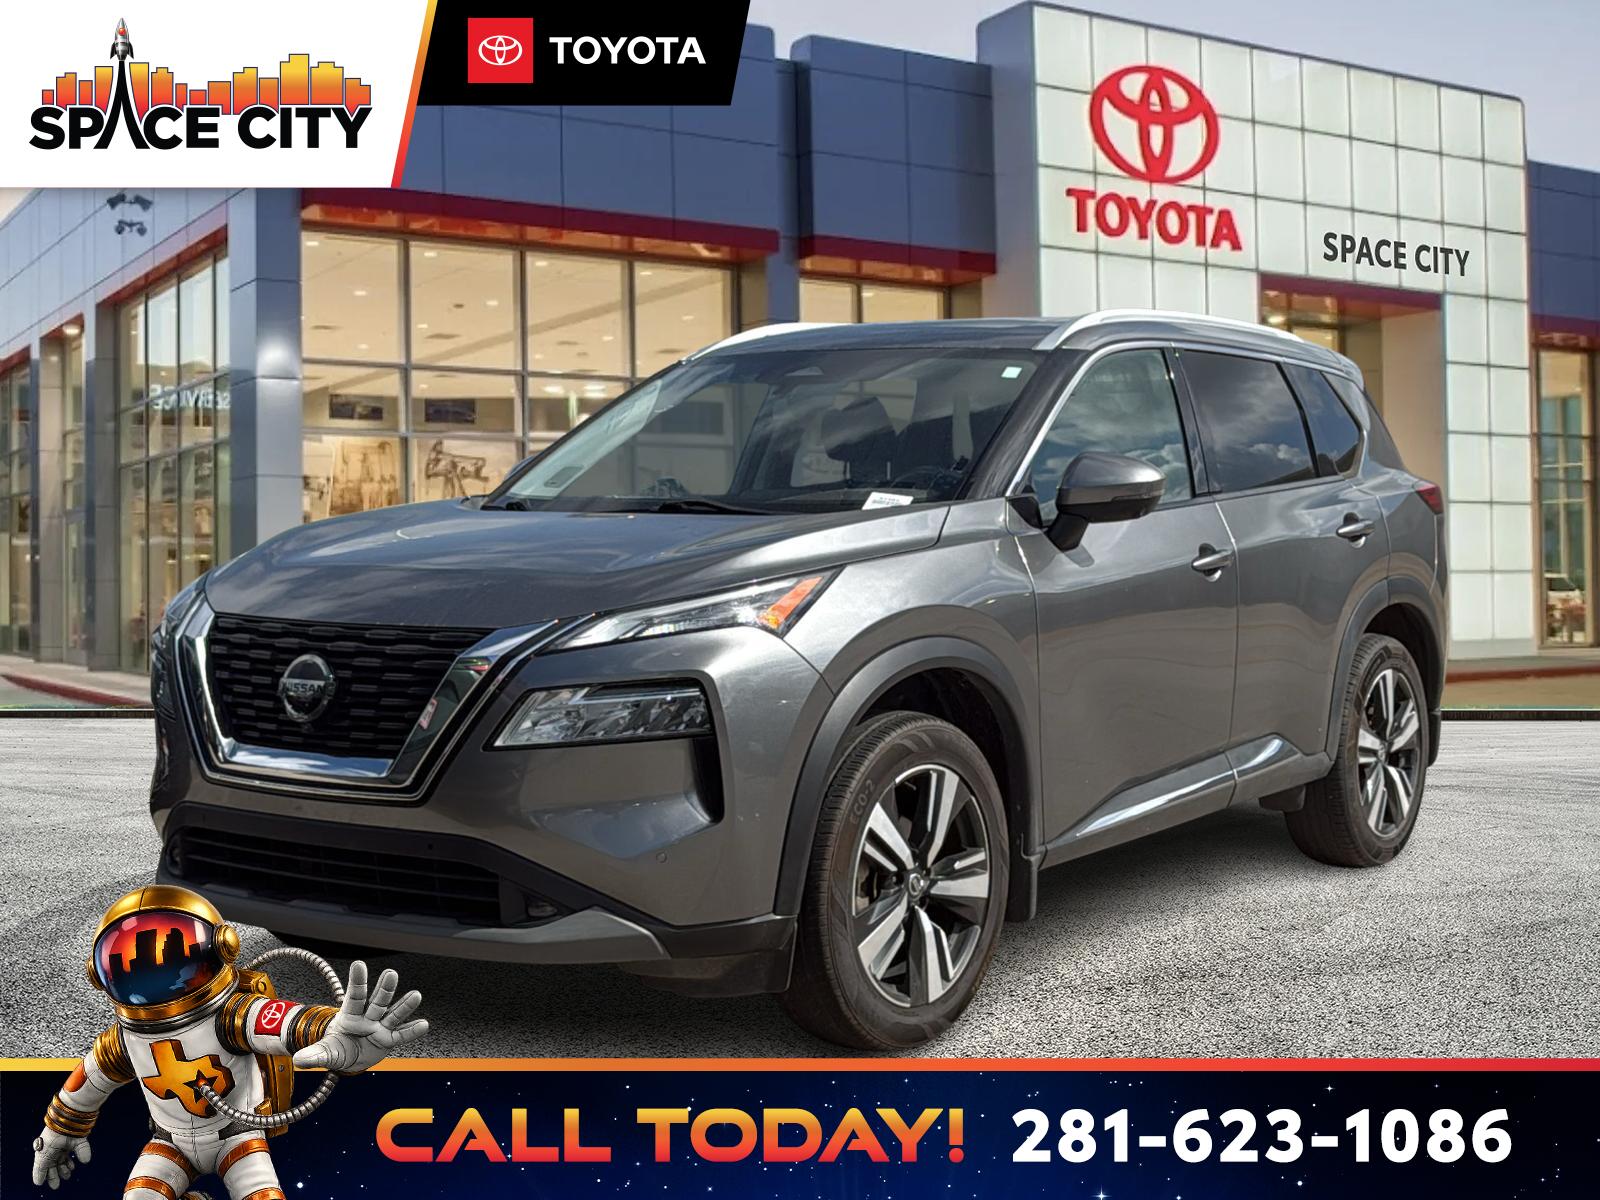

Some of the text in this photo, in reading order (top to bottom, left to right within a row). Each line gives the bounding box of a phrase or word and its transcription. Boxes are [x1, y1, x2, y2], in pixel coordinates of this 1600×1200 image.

[1066, 187, 1243, 251] TOYOTA
[1323, 231, 1471, 277] SPACE CITY
